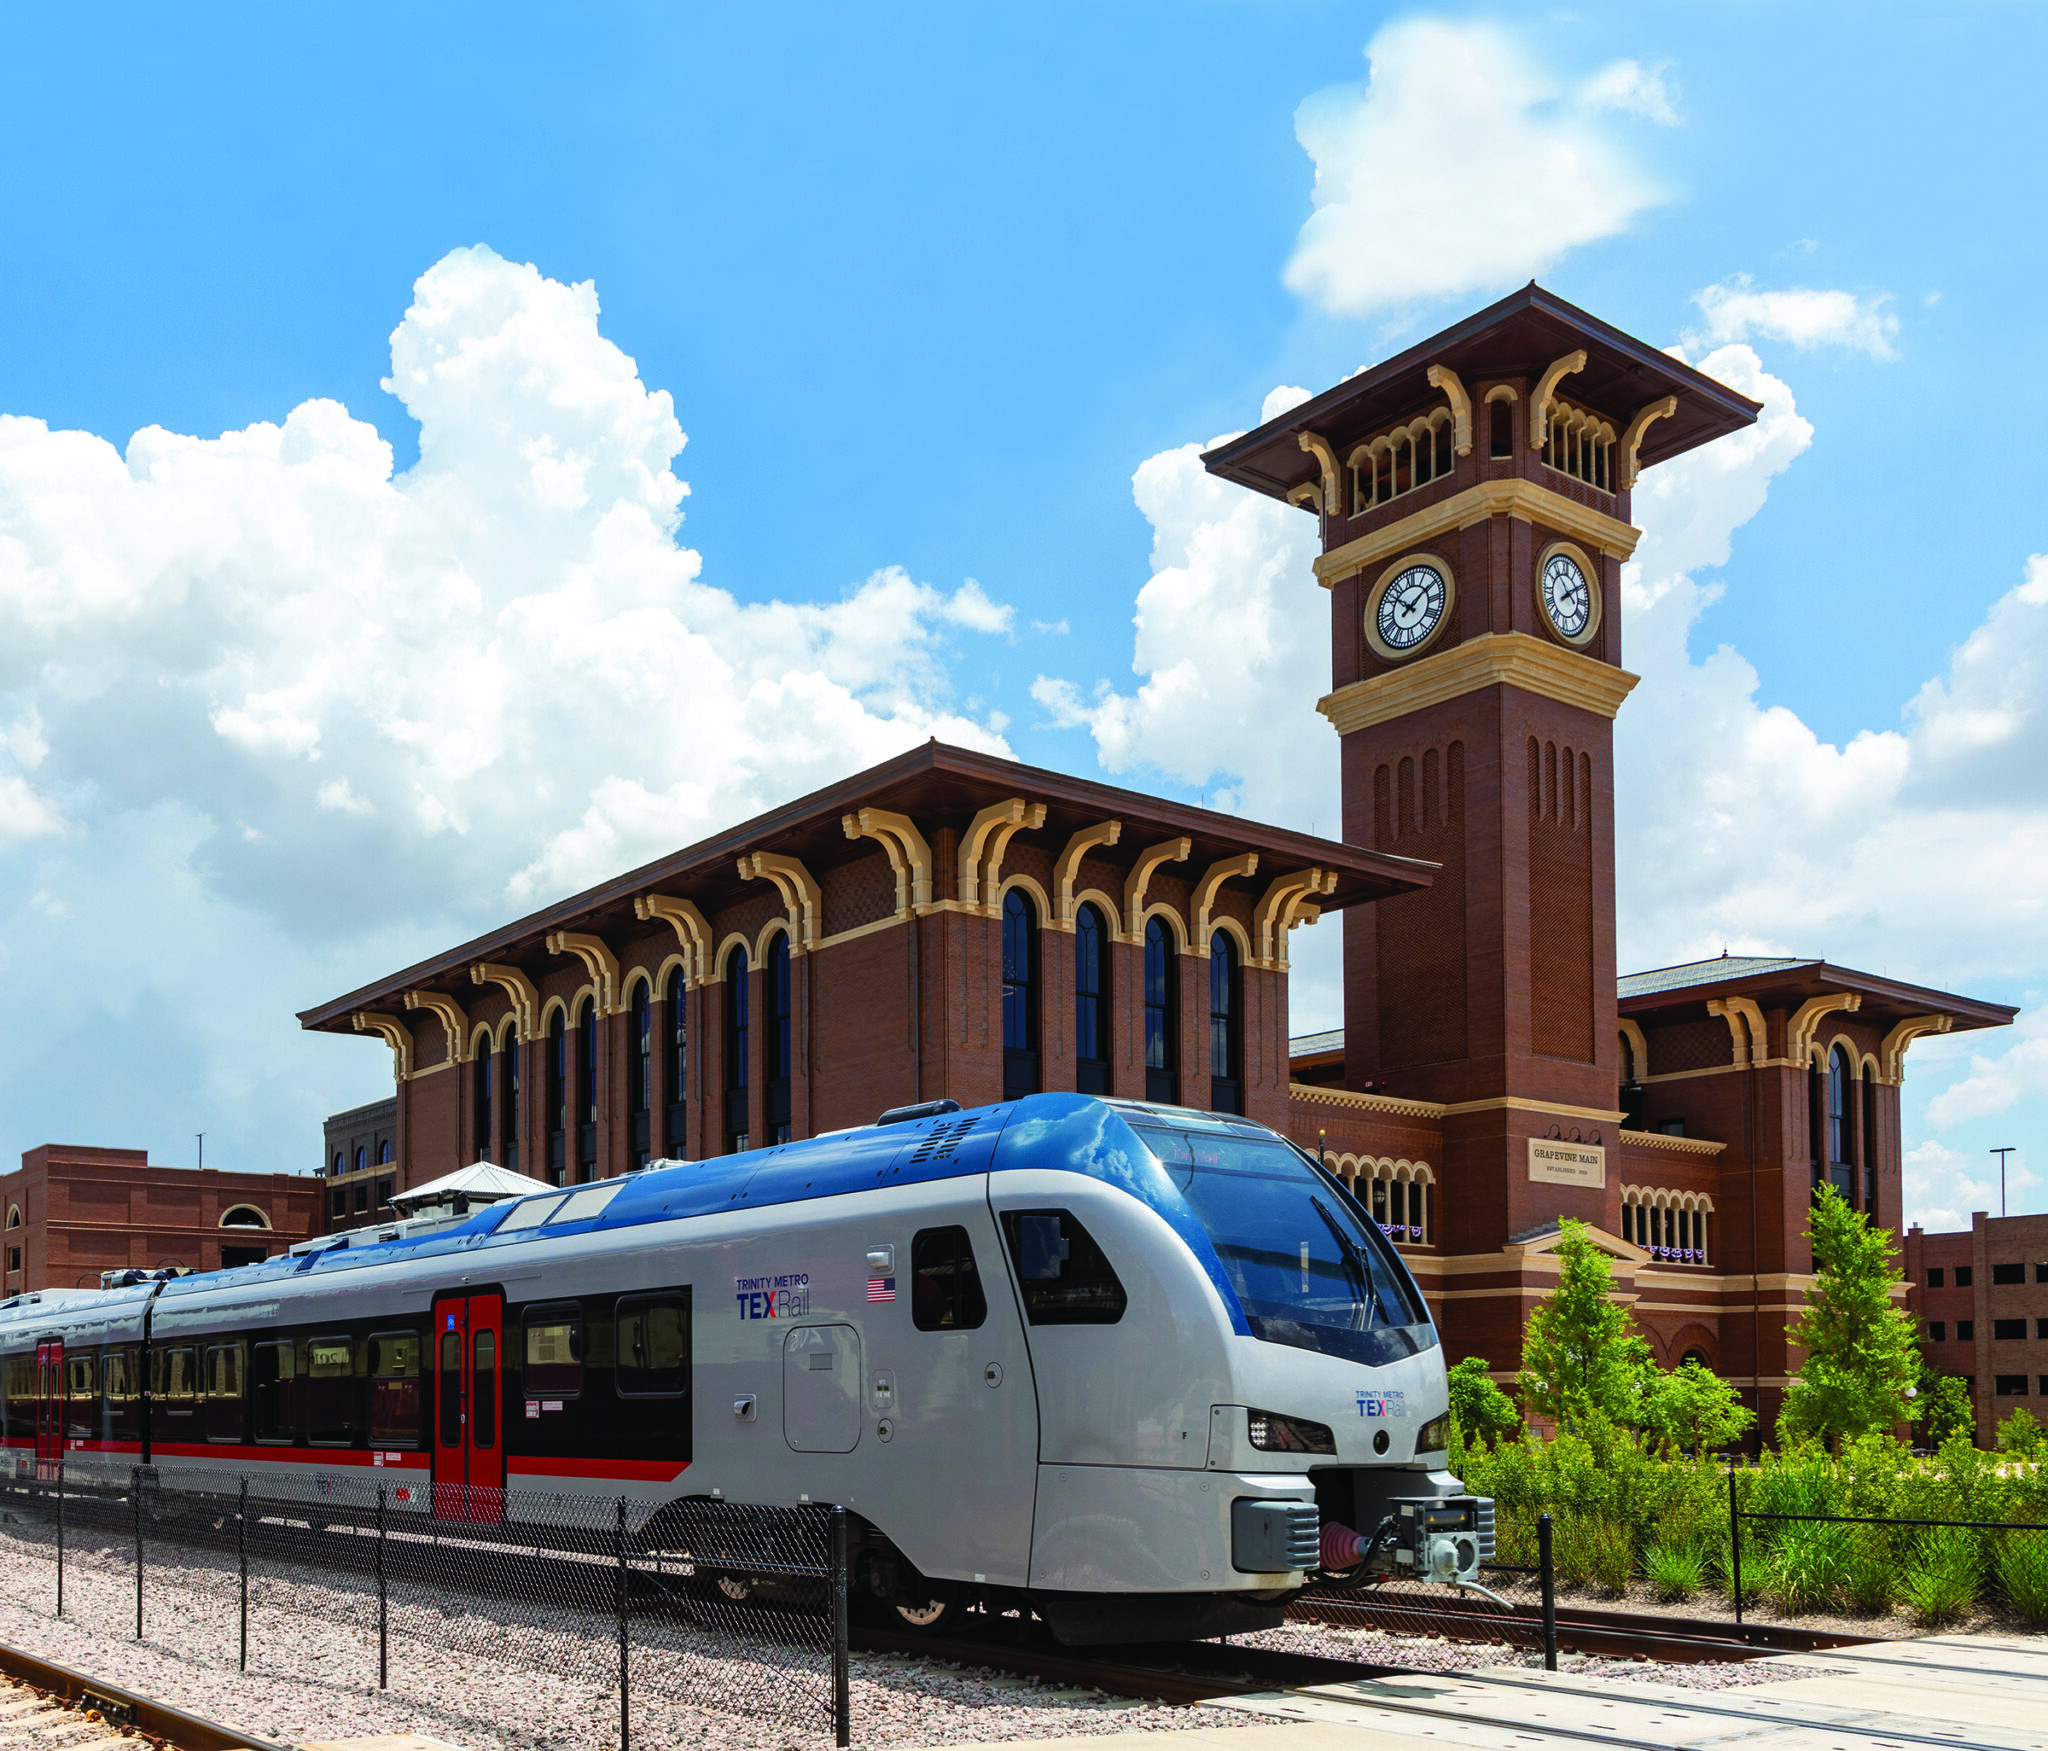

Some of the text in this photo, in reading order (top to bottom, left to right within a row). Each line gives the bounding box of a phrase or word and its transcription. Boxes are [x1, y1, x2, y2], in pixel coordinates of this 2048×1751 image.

[1534, 1148, 1599, 1165] GRAPEVINE MAIN
[736, 1273, 809, 1291] TRINITY METRO
[736, 1287, 810, 1320] TEXRail
[1355, 1390, 1405, 1399] TRINITY METRO
[1356, 1399, 1406, 1417] TEXRail
